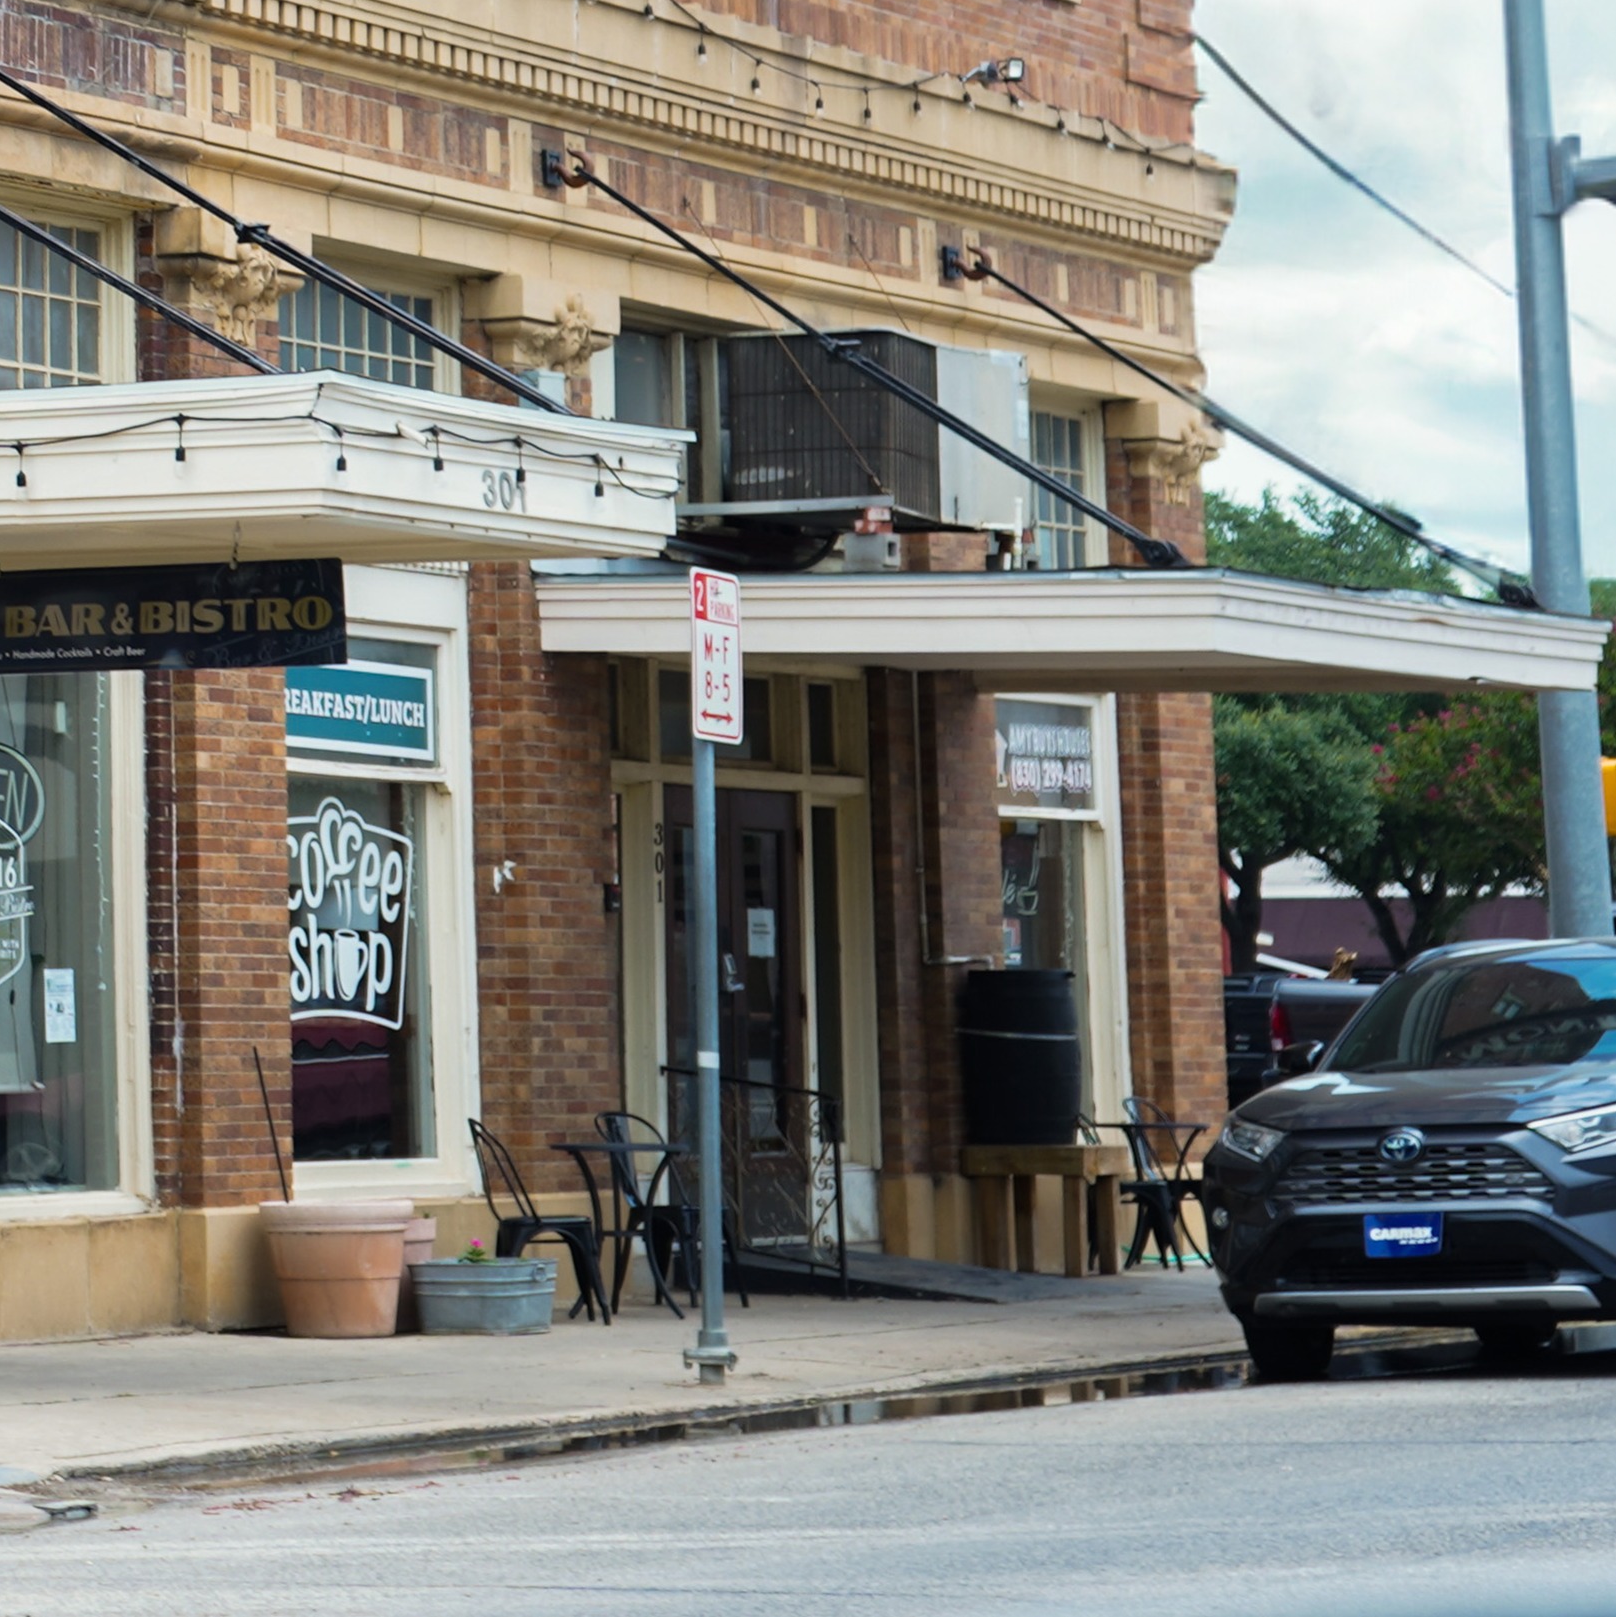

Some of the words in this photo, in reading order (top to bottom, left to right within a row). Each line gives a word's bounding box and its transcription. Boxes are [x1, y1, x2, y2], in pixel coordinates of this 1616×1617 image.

[482, 469, 527, 514] 301
[696, 580, 704, 612] 2
[4, 602, 106, 639] BAR
[110, 602, 136, 636] &
[139, 596, 334, 634] BISTRO
[12, 647, 55, 660] Handmade
[56, 647, 94, 659] Cocktails
[126, 645, 146, 656] Beer
[704, 633, 730, 664] M-F
[705, 671, 730, 702] 8-5
[285, 687, 425, 729] REAKFAST/LUNCH
[654, 822, 664, 903] 301
